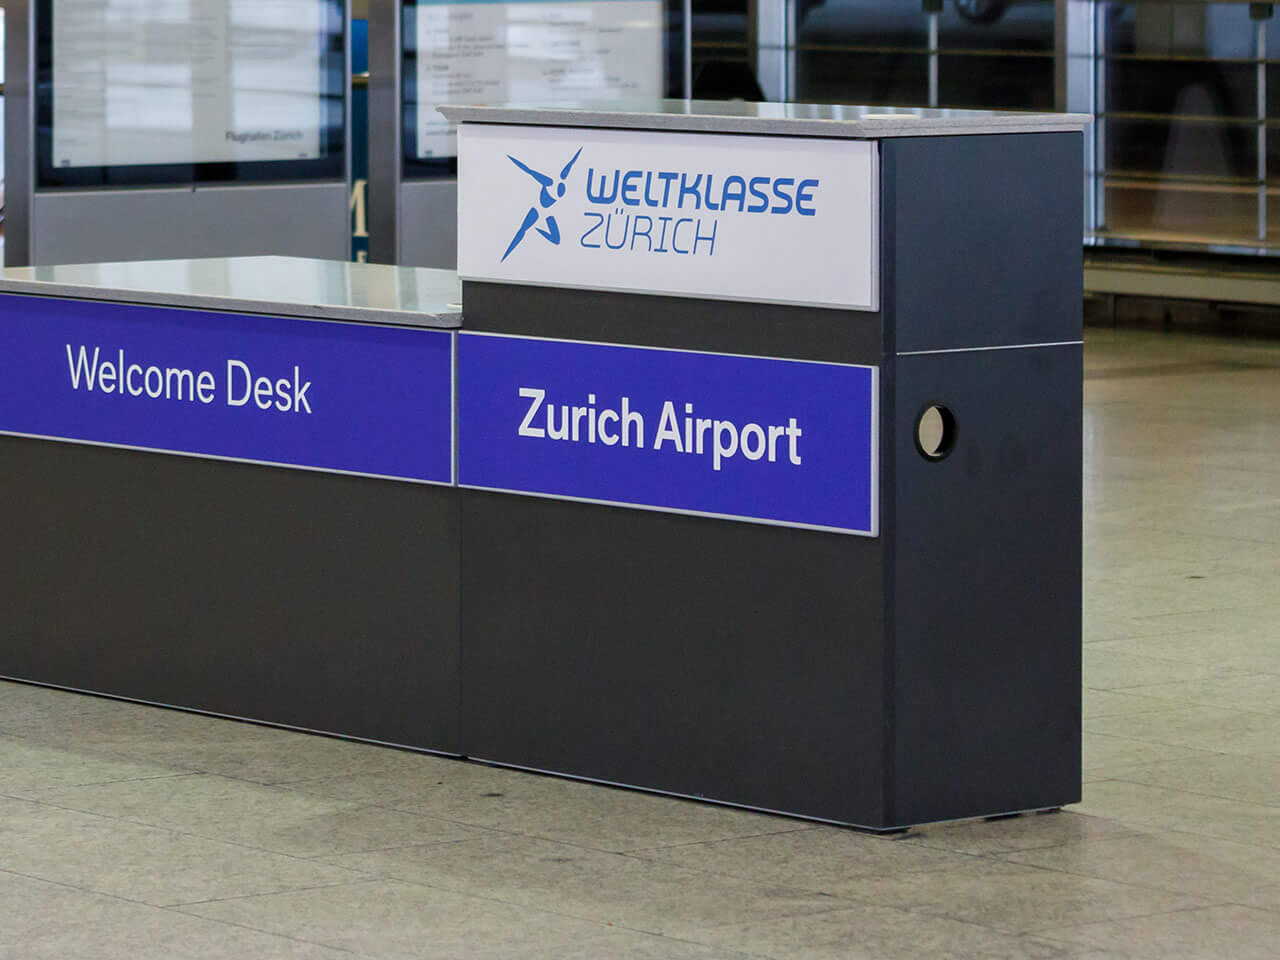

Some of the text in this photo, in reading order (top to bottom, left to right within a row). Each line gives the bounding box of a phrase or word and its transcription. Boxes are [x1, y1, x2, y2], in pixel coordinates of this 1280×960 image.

[586, 168, 819, 216] WELTKLASSE
[580, 207, 718, 256] ZÜRICH
[66, 343, 313, 414] Welcome Desk
[518, 387, 802, 470] Zurich Airport
